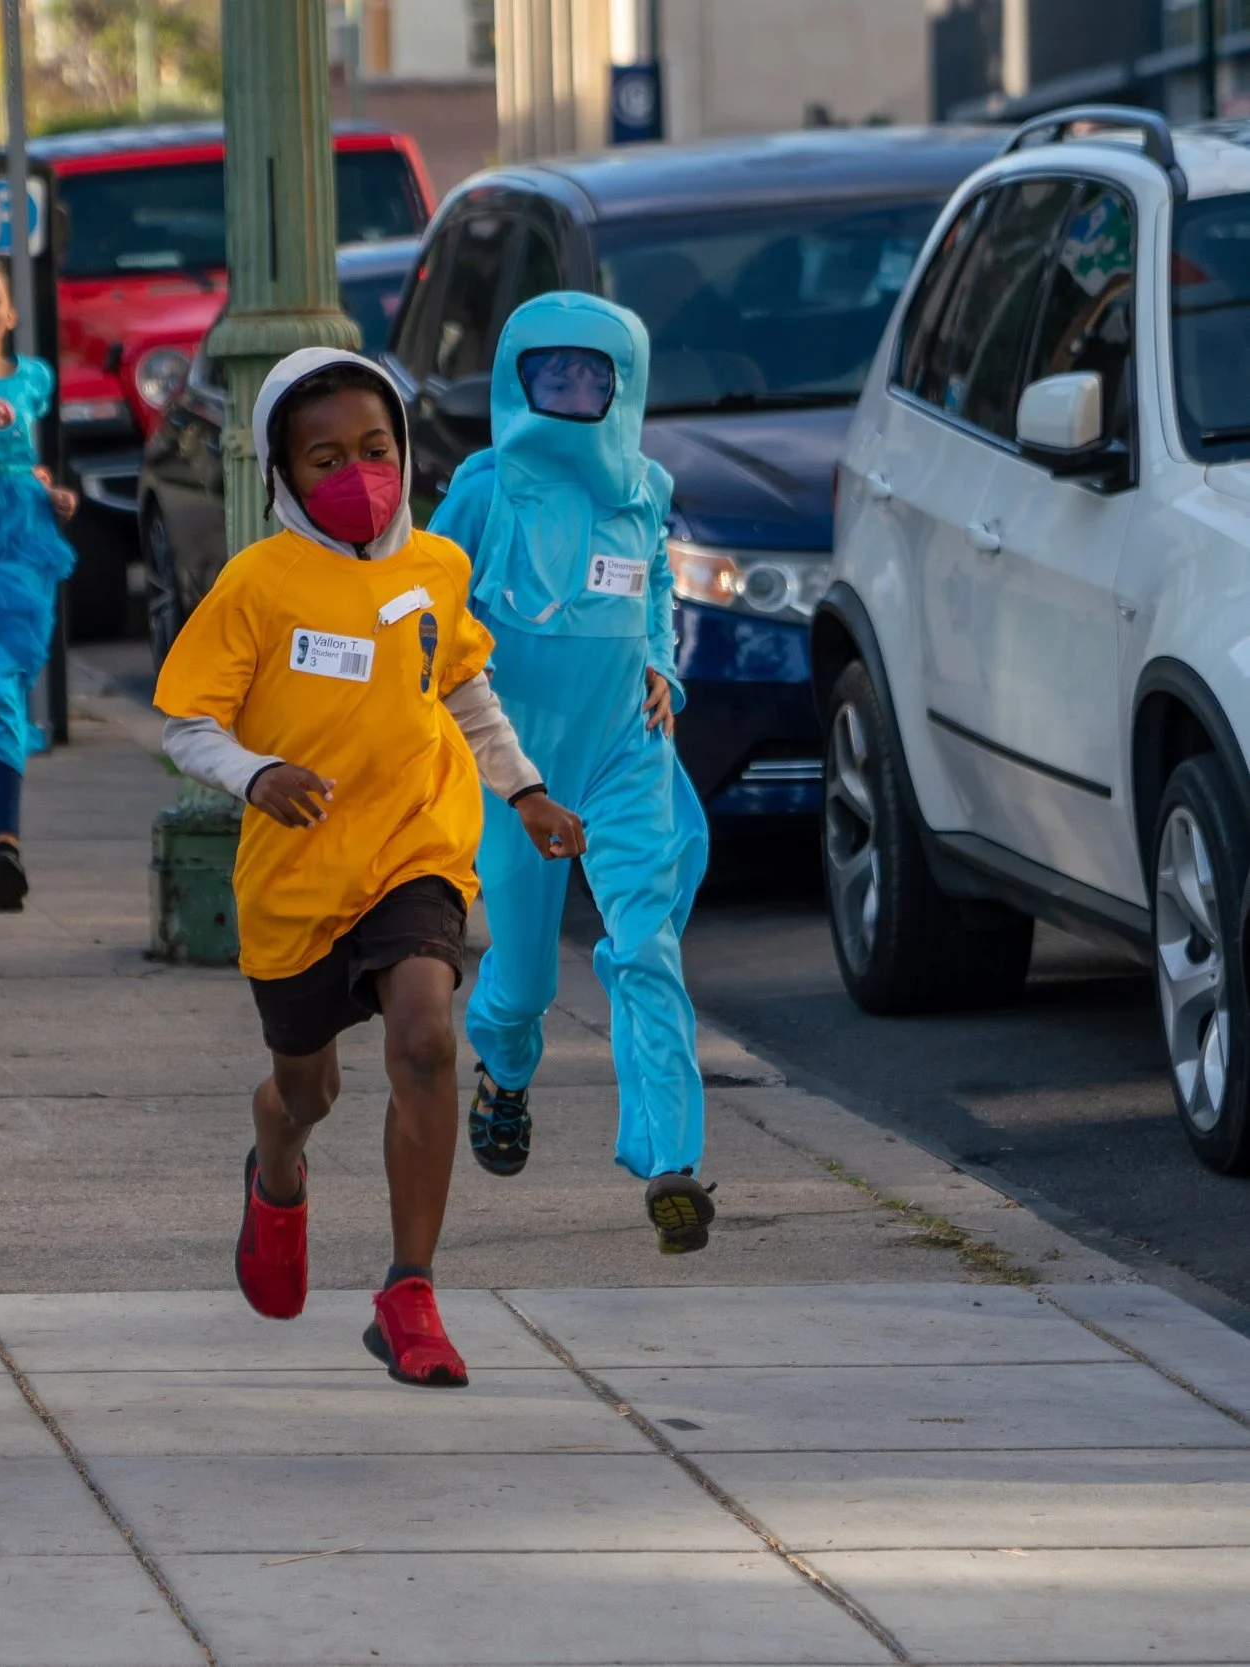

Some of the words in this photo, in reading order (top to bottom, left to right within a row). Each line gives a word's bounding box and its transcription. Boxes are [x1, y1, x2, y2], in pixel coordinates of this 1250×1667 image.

[605, 579, 611, 587] 4
[313, 635, 347, 650] Vallon
[350, 640, 359, 652] T.
[310, 648, 339, 658] Student
[310, 656, 317, 667] 3
